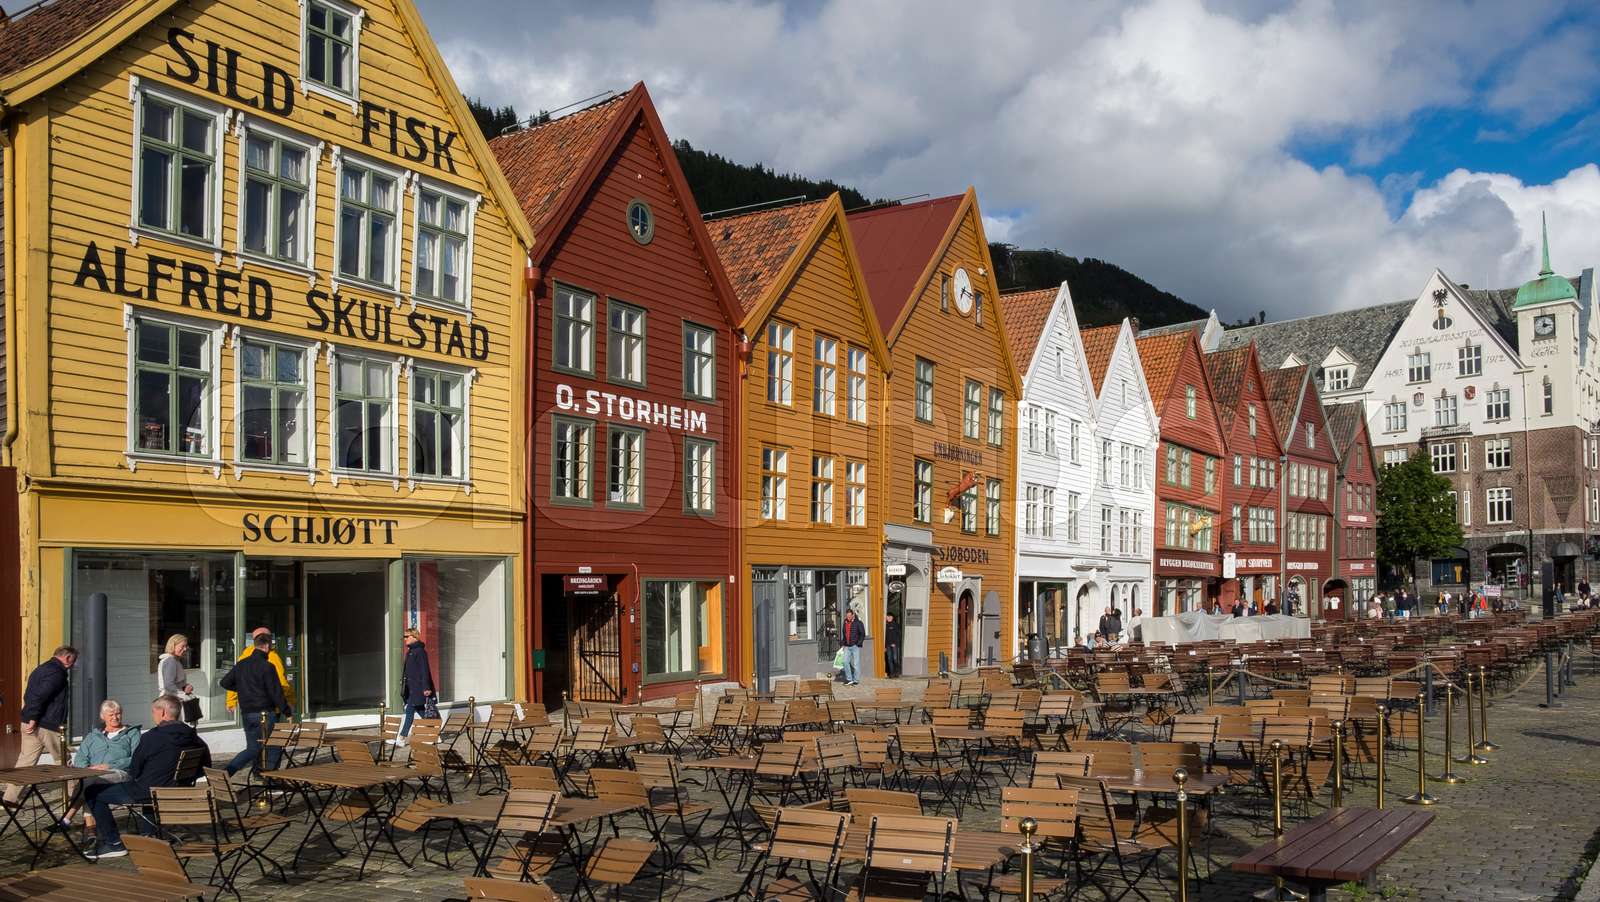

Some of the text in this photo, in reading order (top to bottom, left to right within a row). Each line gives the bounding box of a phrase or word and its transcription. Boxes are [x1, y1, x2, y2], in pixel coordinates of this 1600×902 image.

[166, 27, 294, 118] SILD
[361, 101, 458, 174] FISK
[73, 241, 490, 361] ALFRED SKULSTAD
[556, 384, 708, 434] O. STORHEIM
[242, 513, 399, 546] SCHJØTT
[939, 546, 989, 564] SJØBODEN
